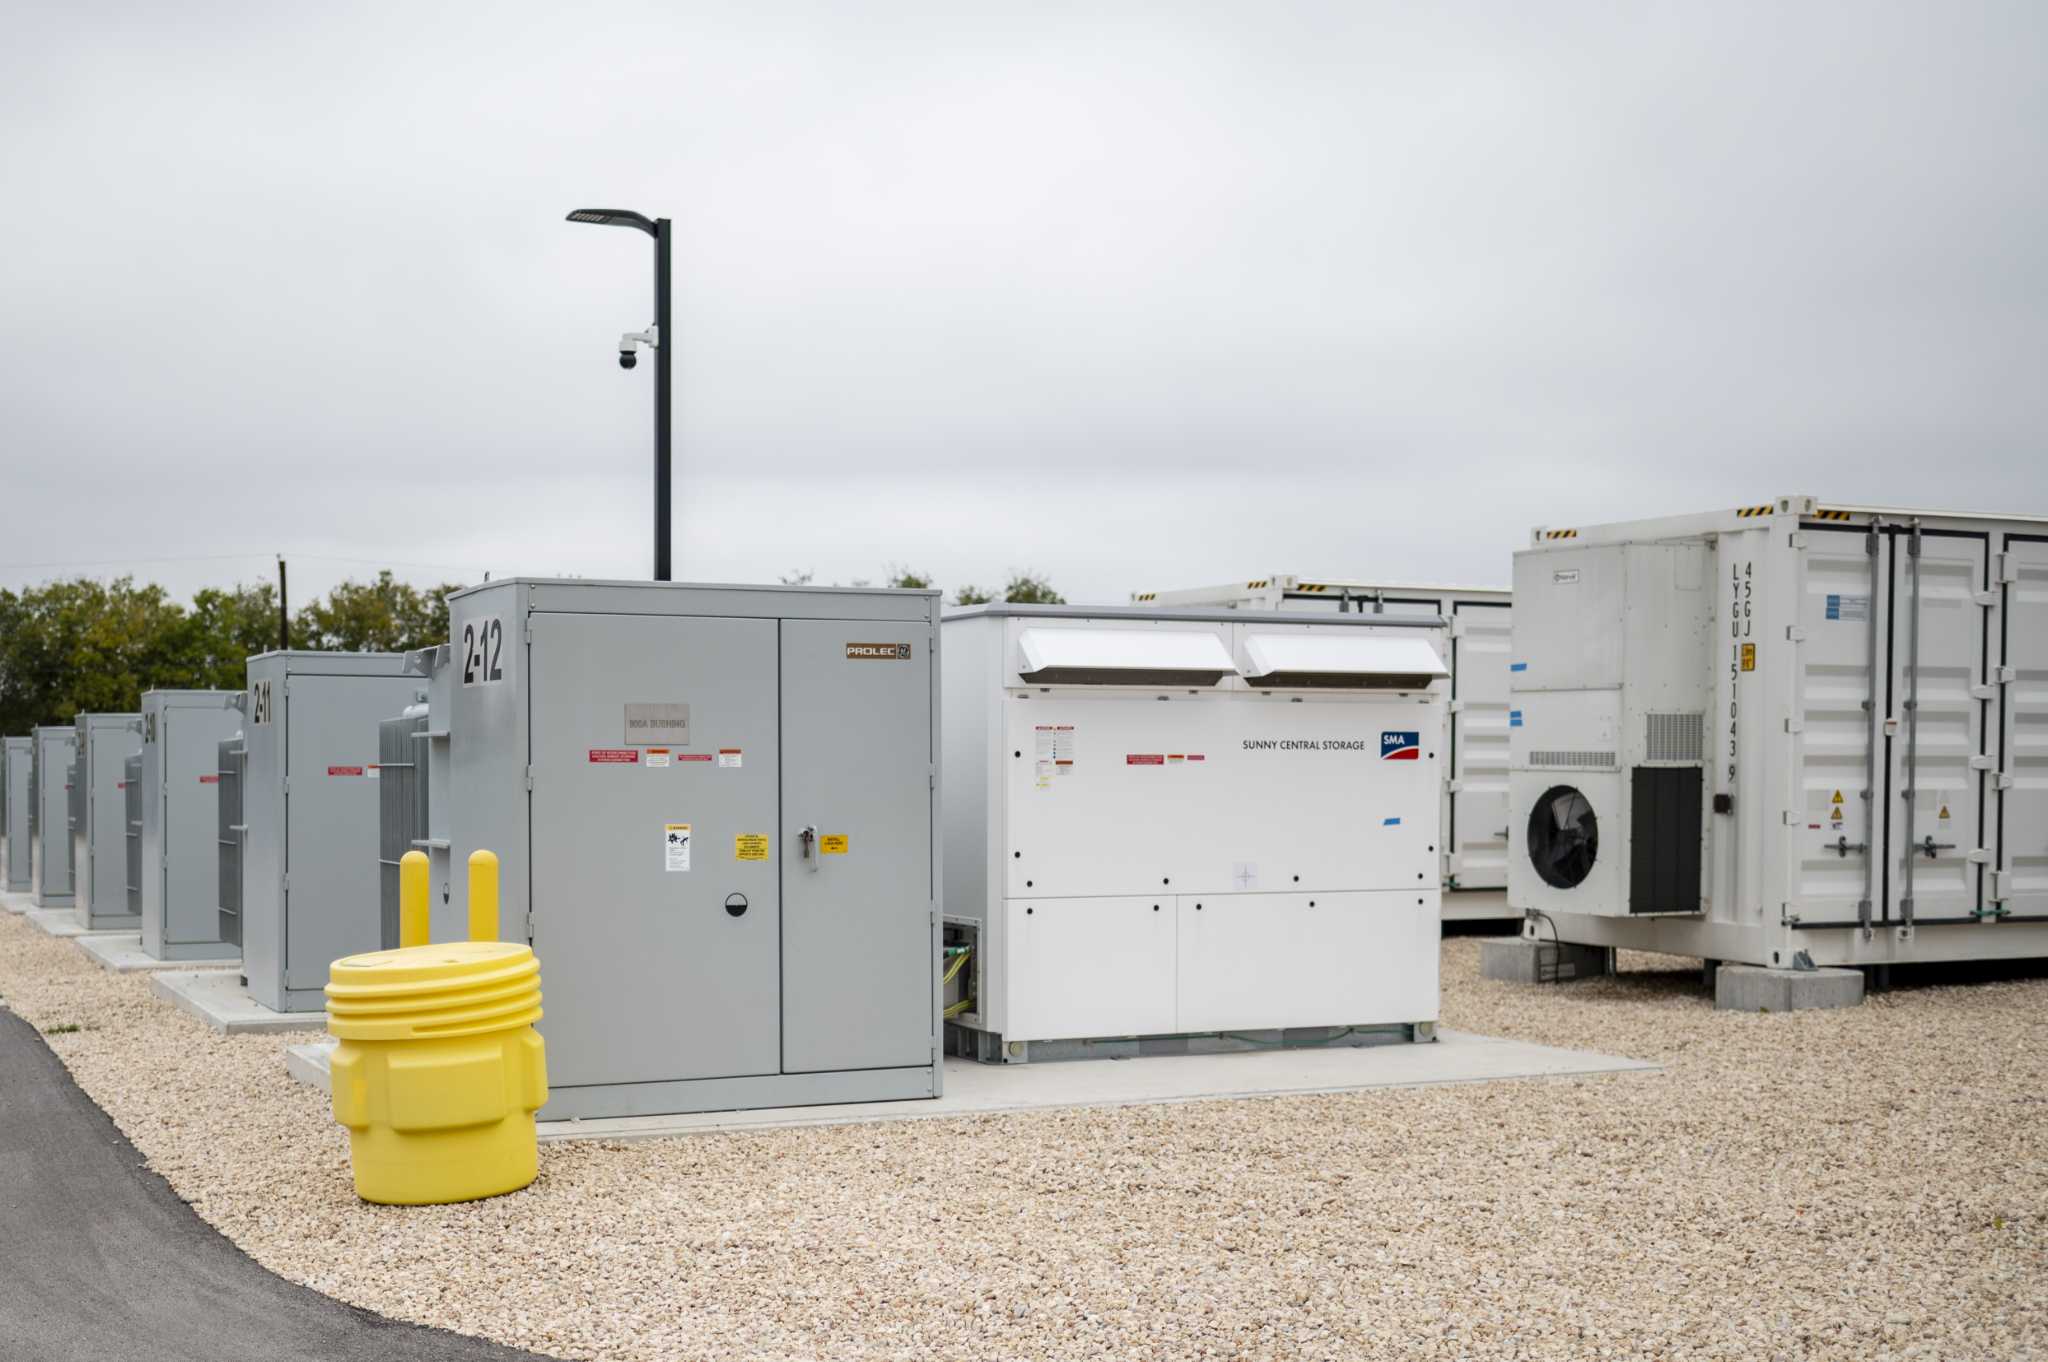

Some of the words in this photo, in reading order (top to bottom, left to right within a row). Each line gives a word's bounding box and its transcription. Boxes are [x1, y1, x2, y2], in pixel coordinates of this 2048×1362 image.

[1732, 563, 1740, 638] LYGU
[1743, 561, 1752, 637] 45GJ
[463, 618, 502, 684] 2-12
[847, 647, 896, 656] PROLEC
[254, 680, 271, 723] 2-11
[1242, 739, 1277, 750] SUNNY
[1279, 740, 1321, 750] CENTRAL
[1322, 740, 1365, 751] STORAGE
[1383, 734, 1405, 745] SMA
